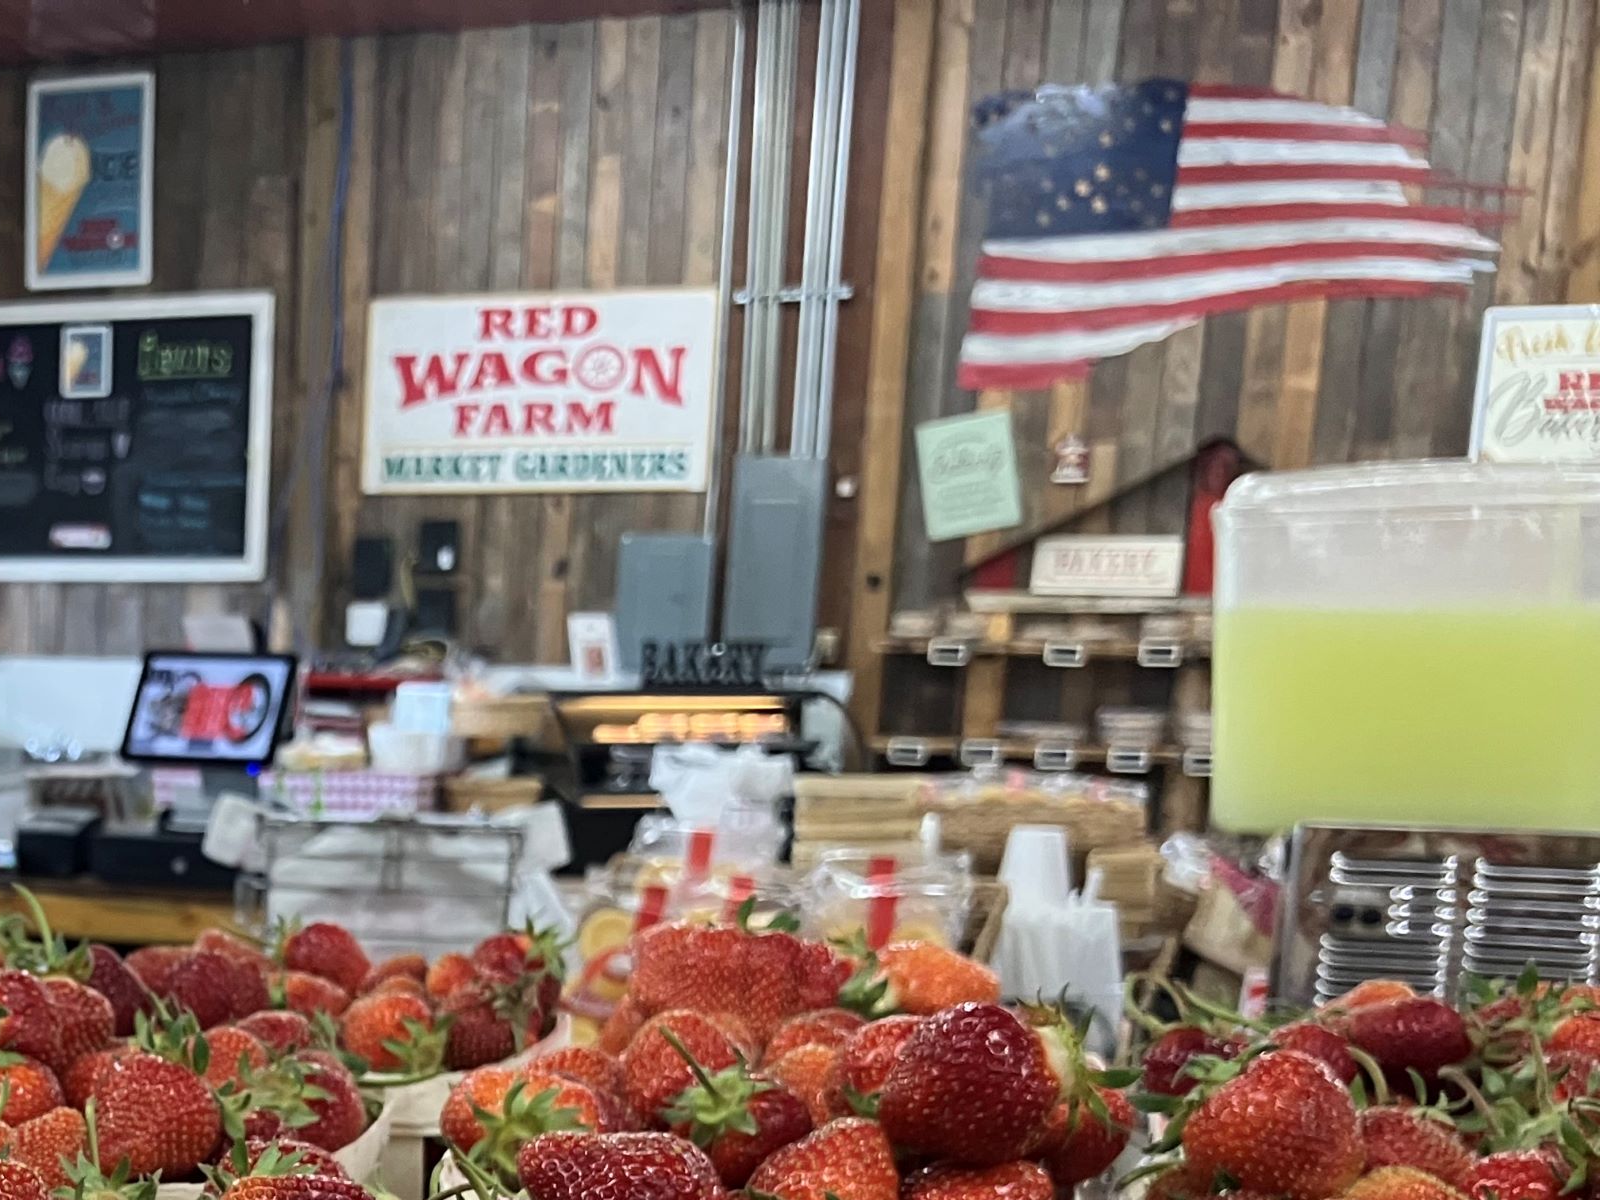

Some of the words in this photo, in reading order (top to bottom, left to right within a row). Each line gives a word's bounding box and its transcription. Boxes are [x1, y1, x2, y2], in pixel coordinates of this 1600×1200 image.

[479, 304, 600, 342] RED
[393, 345, 688, 411] WAGON
[453, 401, 617, 438] FARM
[384, 453, 504, 483] MARKET
[514, 452, 690, 482] GARDENERS
[642, 641, 768, 686] BAKERY
